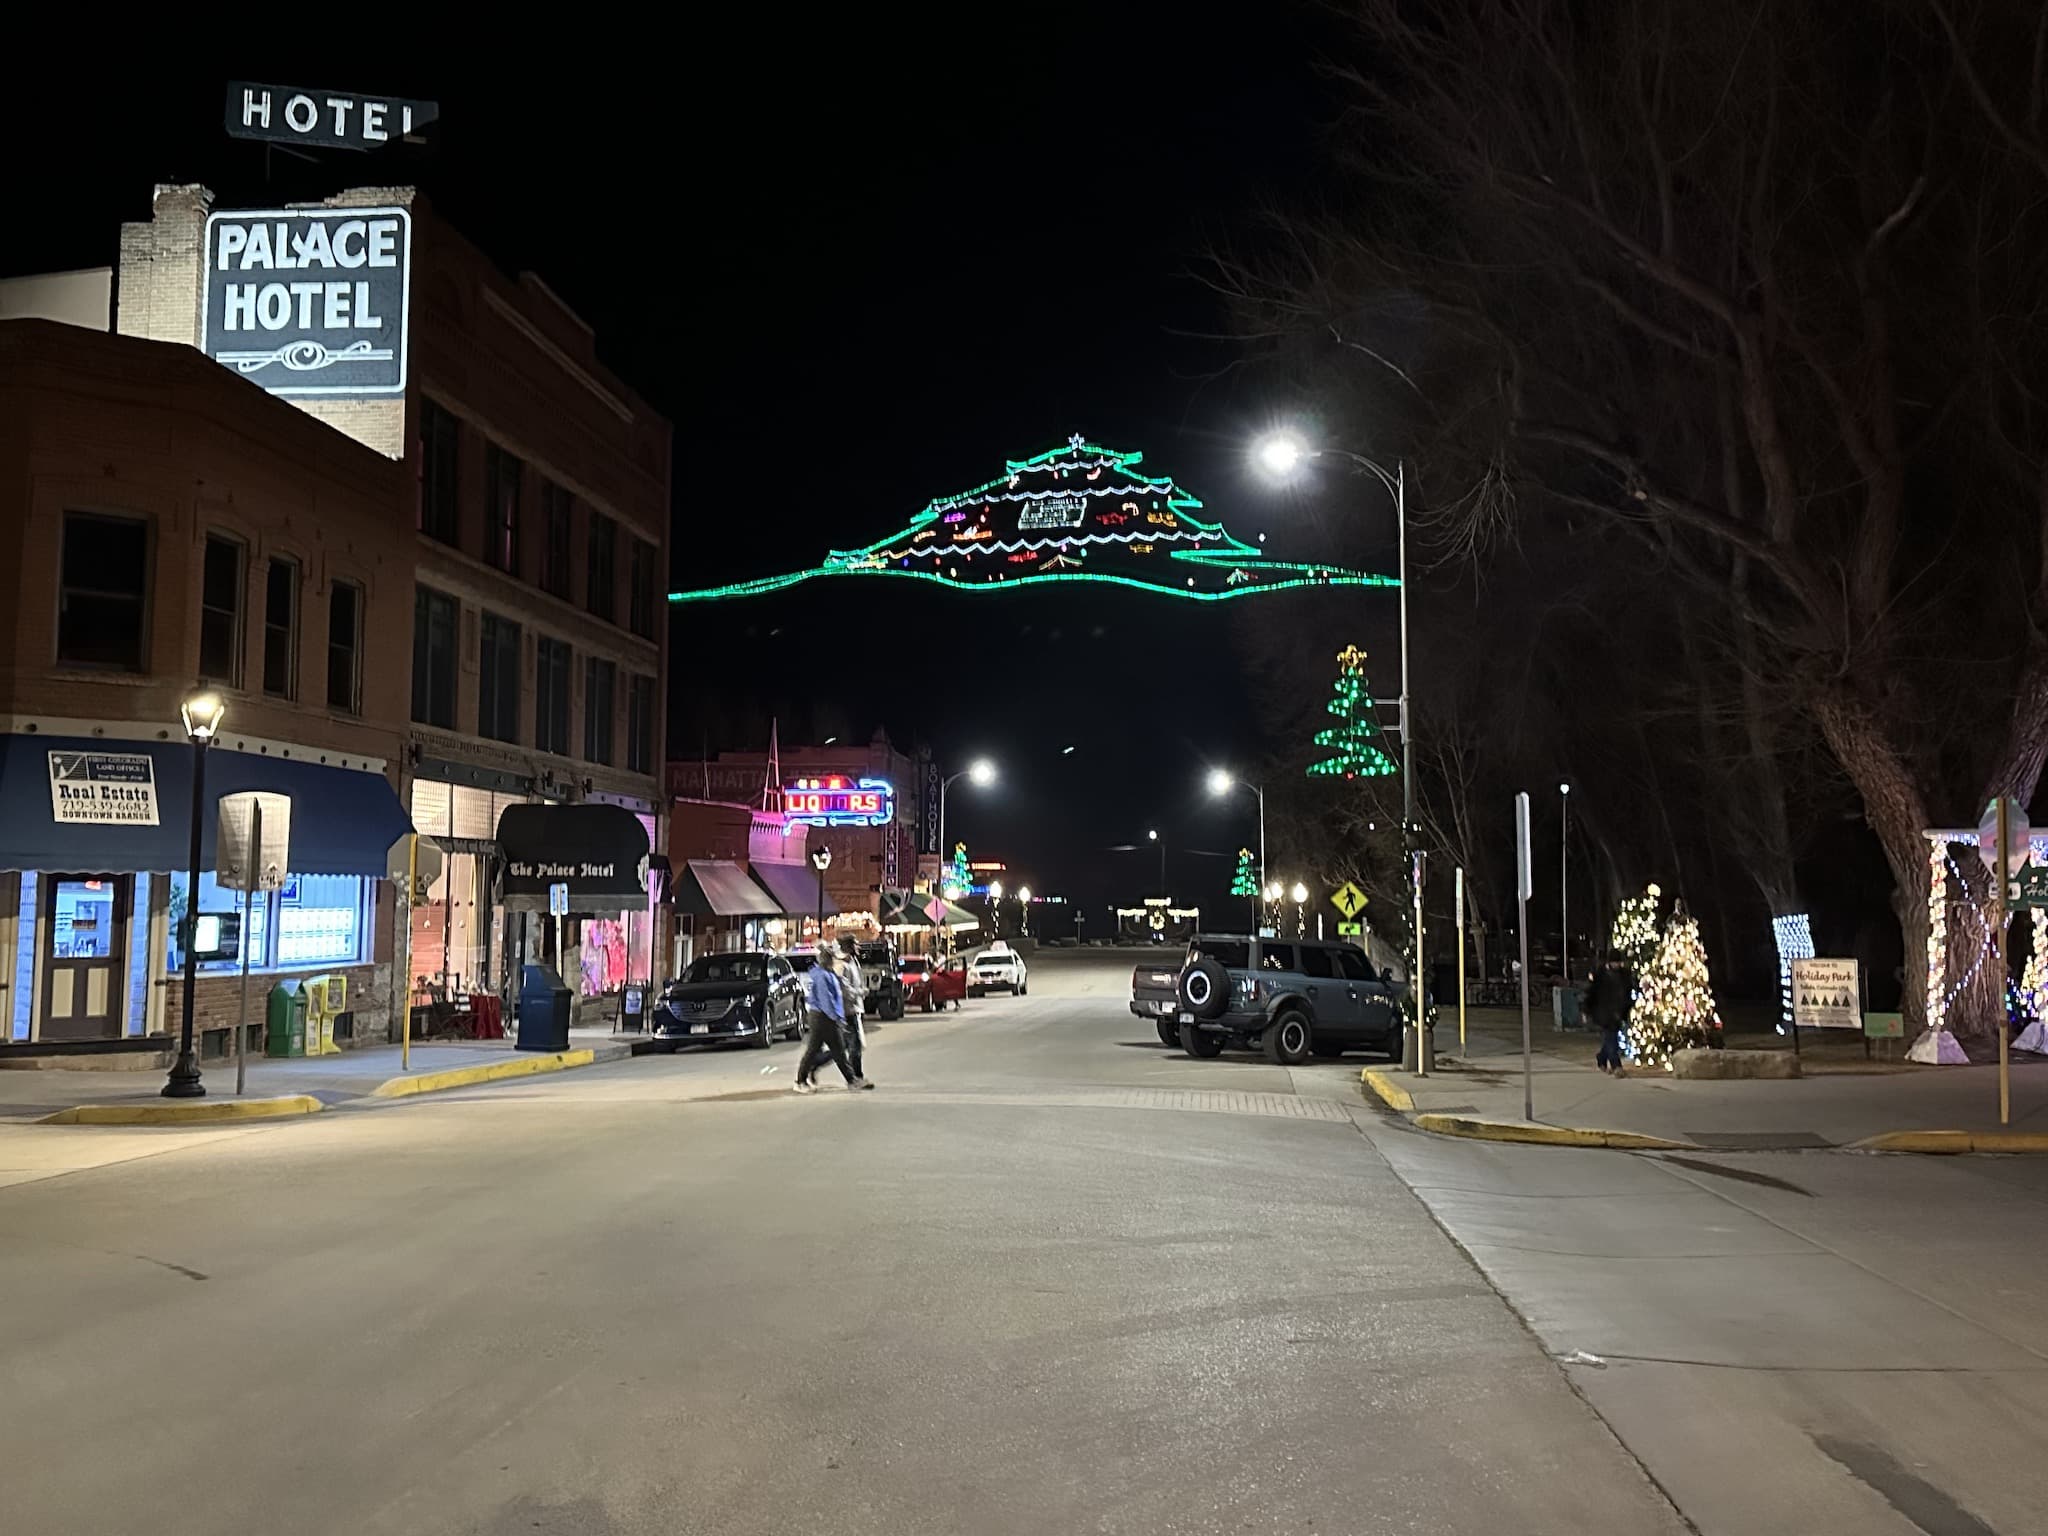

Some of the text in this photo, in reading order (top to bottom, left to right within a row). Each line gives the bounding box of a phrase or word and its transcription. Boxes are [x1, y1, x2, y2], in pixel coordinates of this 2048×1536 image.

[242, 87, 426, 144] HOTEL
[217, 219, 399, 271] PALACE
[223, 280, 382, 331] HOTEL
[58, 784, 149, 801] Real Estate
[788, 795, 877, 812] LIQUORS
[927, 763, 938, 852] BOATHOUSE
[62, 810, 113, 819] DOWNTOWN
[510, 862, 614, 879] The Palace Hotel
[1796, 971, 1852, 983] Holiday Park
